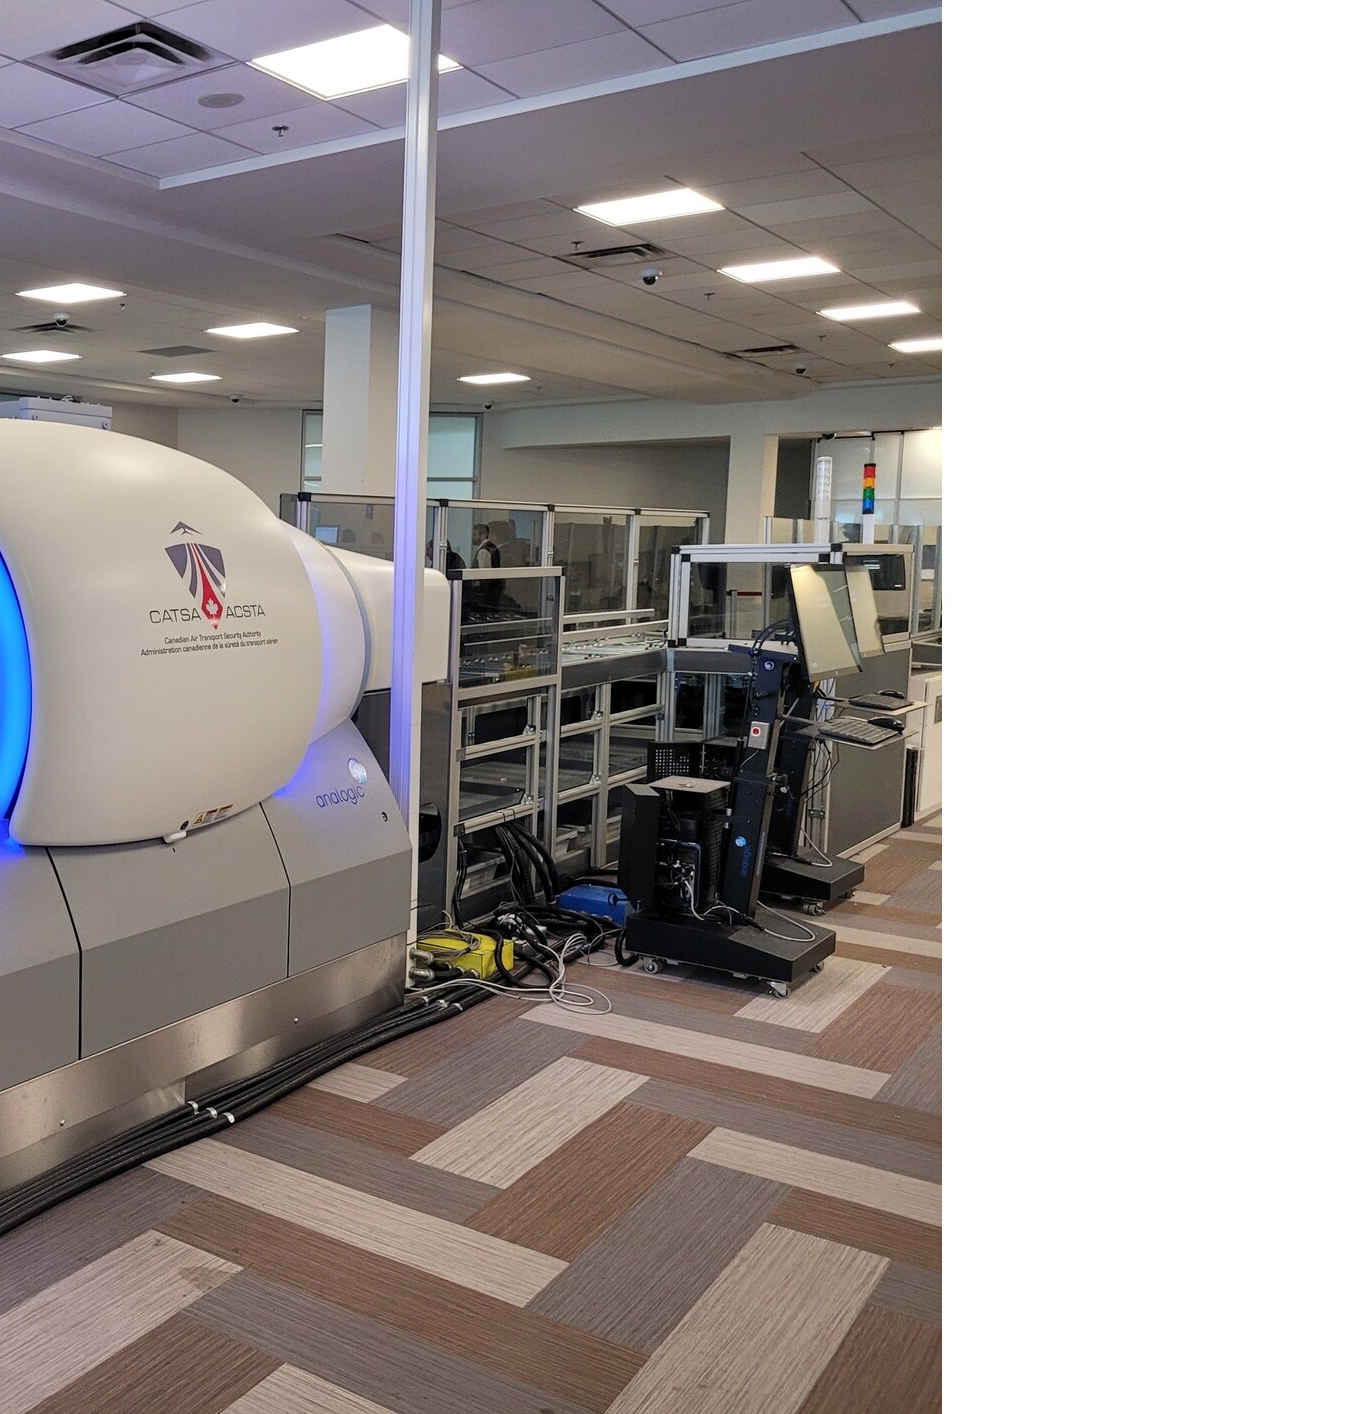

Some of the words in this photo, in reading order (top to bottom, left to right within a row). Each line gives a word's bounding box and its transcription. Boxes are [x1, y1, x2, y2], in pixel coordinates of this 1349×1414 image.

[149, 607, 202, 624] CATSA
[225, 604, 266, 619] ACSTA
[164, 635, 190, 645] Canadian
[190, 634, 198, 642] Air
[198, 633, 223, 642] Transport
[223, 631, 242, 640] Security
[242, 630, 262, 638] Authority
[140, 646, 182, 657] Administration
[182, 643, 212, 653] canadienne
[212, 642, 219, 650] de
[246, 638, 267, 647] transport
[315, 786, 365, 808] analogic
